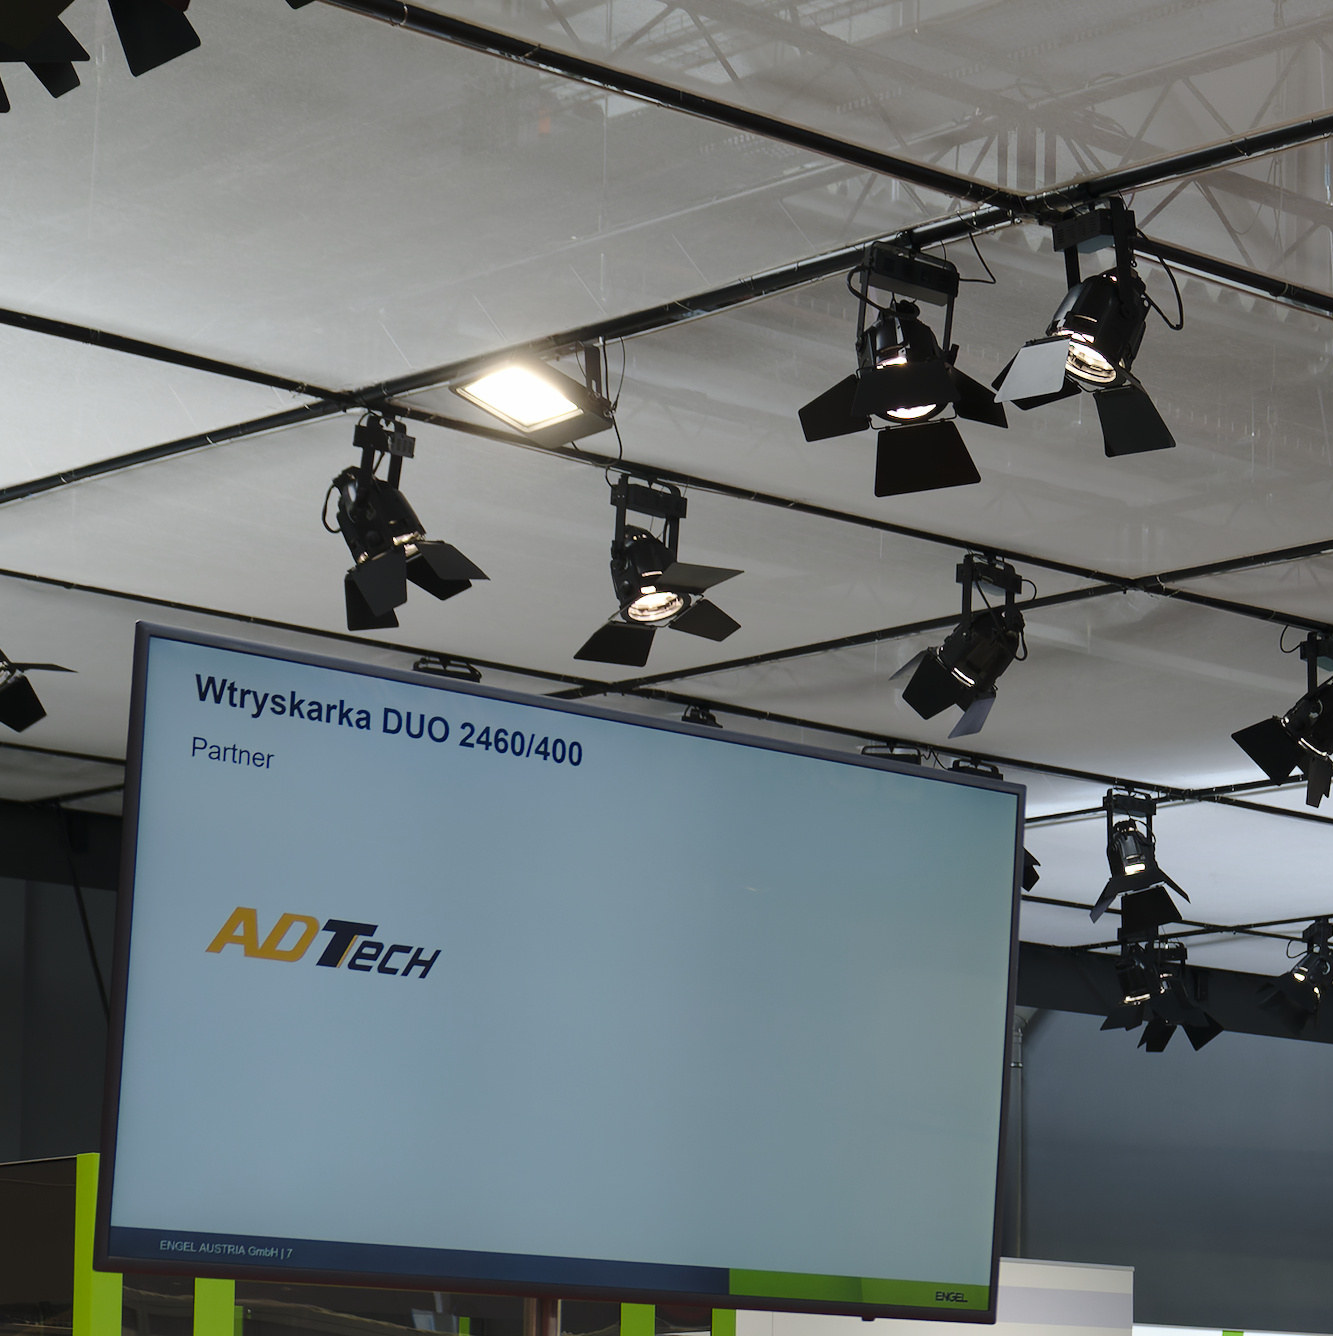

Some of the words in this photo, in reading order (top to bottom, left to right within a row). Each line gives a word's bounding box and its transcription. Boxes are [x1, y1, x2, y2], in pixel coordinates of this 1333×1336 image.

[195, 673, 372, 731] Wtryskarka
[381, 707, 450, 743] DUO
[458, 722, 583, 767] 2460/400
[191, 736, 275, 769] Partner
[160, 1240, 197, 1253] ENGEL
[199, 1242, 246, 1256] AUSTRIA
[247, 1246, 279, 1258] GmbH
[286, 1248, 293, 1259] 7
